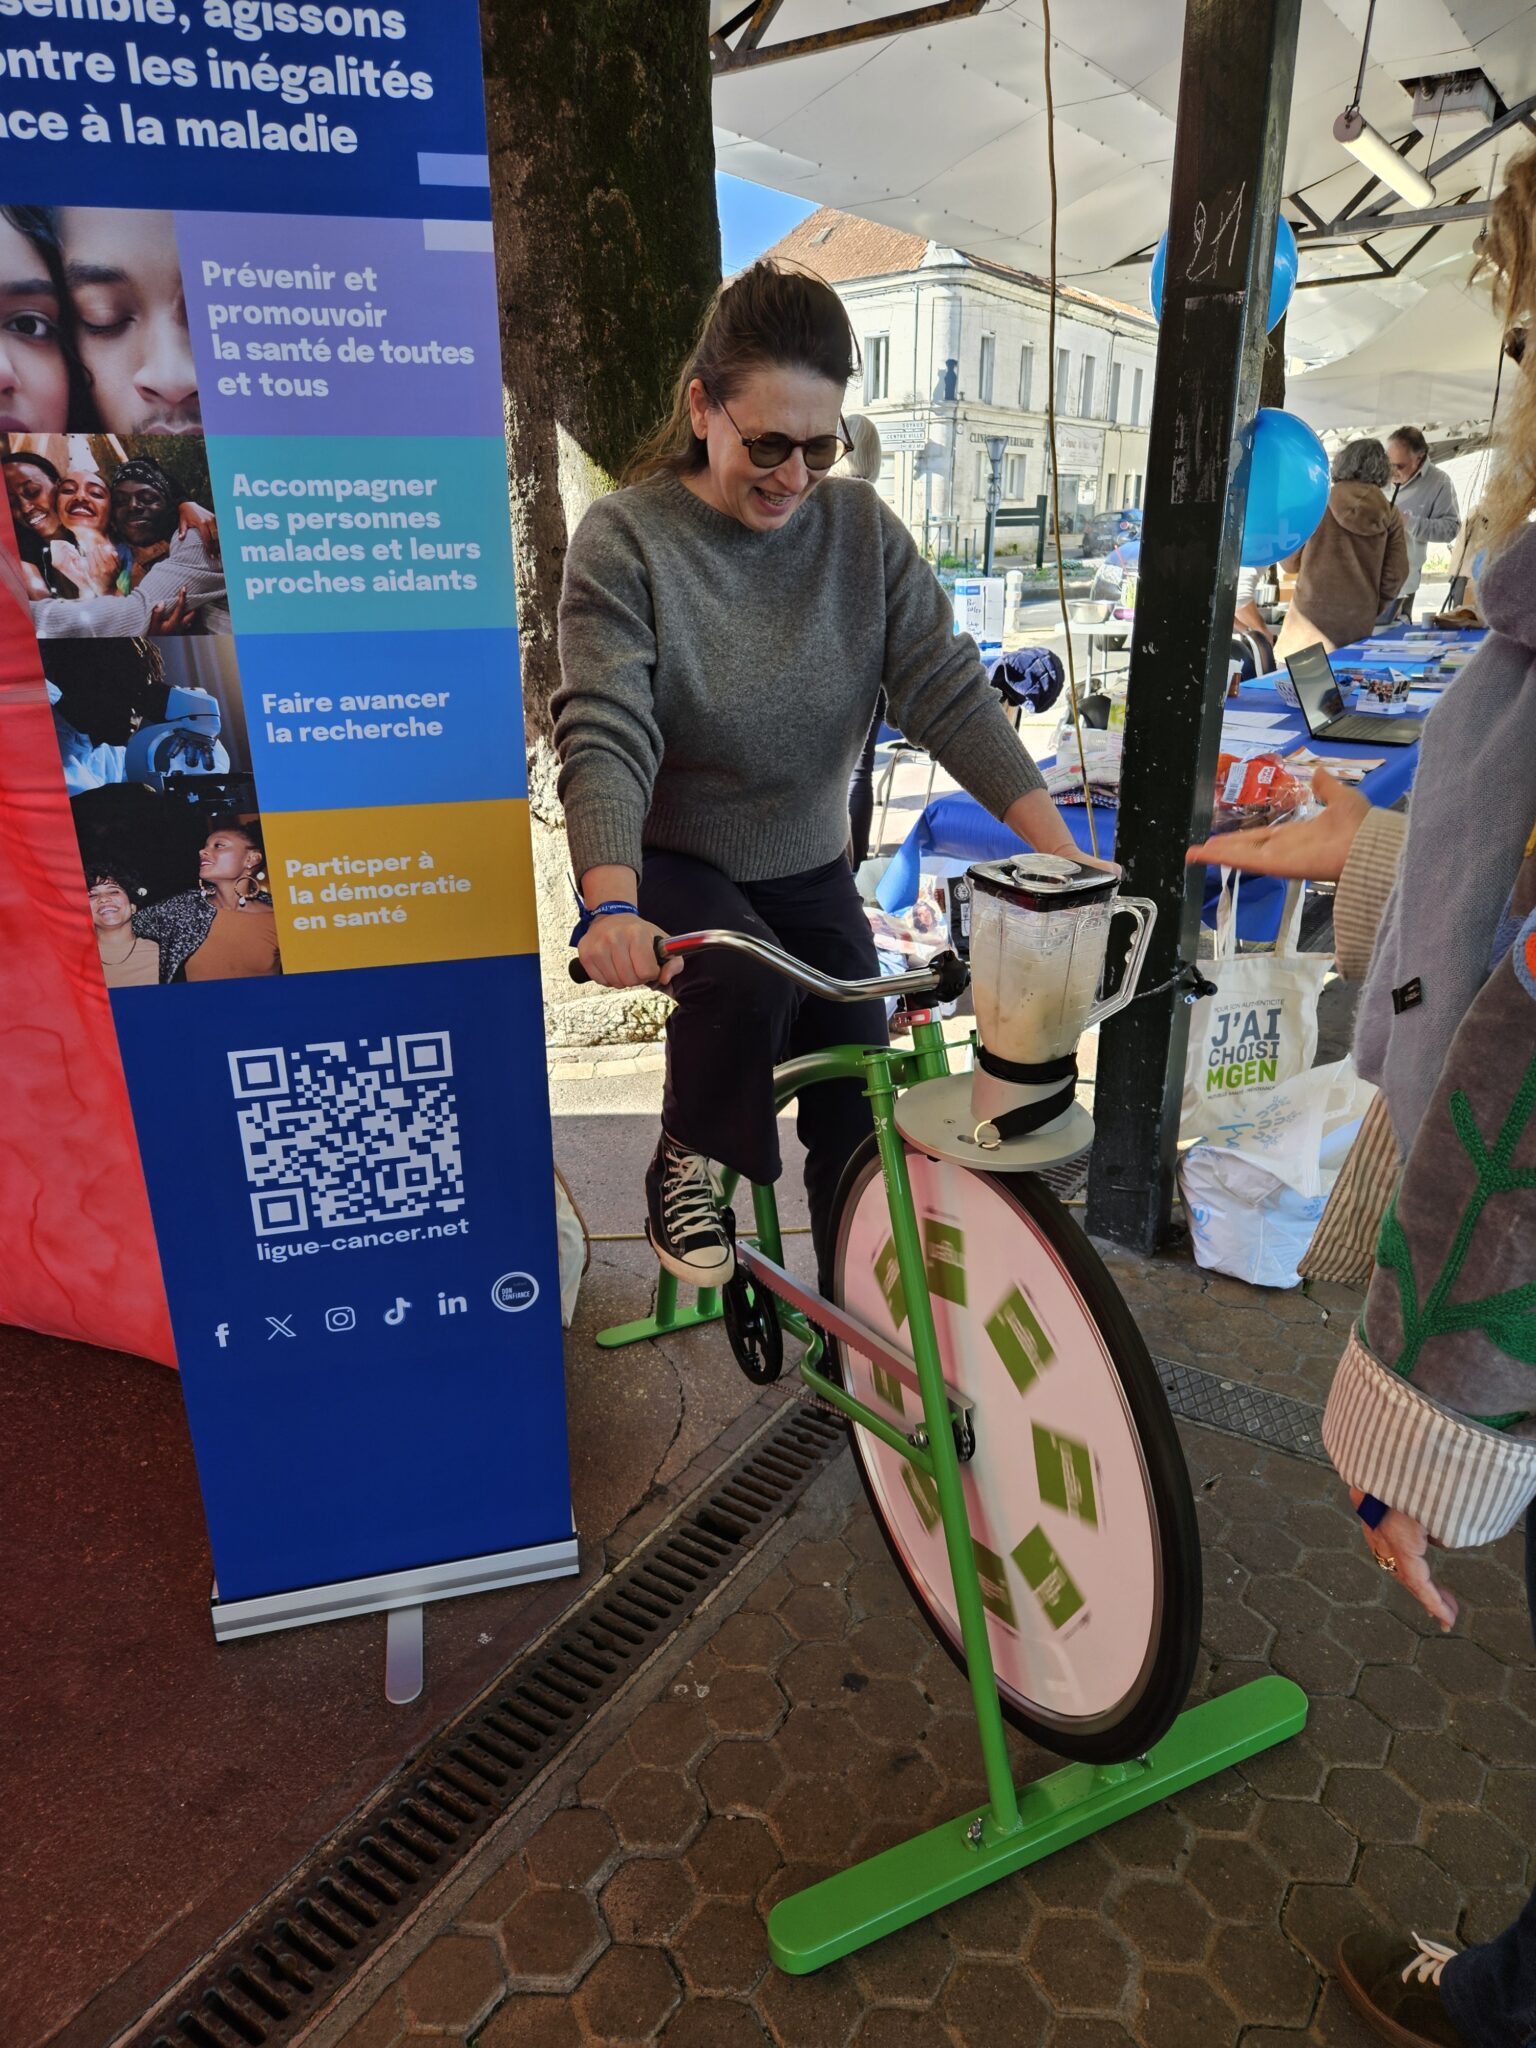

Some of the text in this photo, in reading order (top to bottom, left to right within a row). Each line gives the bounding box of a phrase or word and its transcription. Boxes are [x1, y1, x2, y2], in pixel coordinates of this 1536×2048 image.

[203, 0, 407, 41] agissons
[126, 41, 198, 88] les
[206, 48, 434, 105] inégalités
[80, 103, 111, 143] à
[119, 103, 166, 145] la
[175, 109, 358, 154] maladie
[201, 260, 378, 292] Prévenir et
[207, 301, 388, 330] promouvoir
[211, 333, 475, 365] la santé de toutes
[217, 372, 329, 397] et tous
[232, 473, 438, 502] Accompagner
[235, 505, 441, 534] les personnes
[240, 537, 481, 562] malades et leurs
[245, 568, 478, 600] proches aidants
[262, 691, 450, 714] Faire avancer
[266, 716, 443, 744] la recherche
[285, 850, 434, 881] Particper à
[288, 874, 471, 905] la démocratie
[292, 906, 407, 931] en santé
[1208, 1041, 1280, 1067] CHOISI
[1206, 1059, 1277, 1093] MGEN
[257, 1218, 470, 1264] ligue-cancer.net
[501, 1287, 513, 1295] DON
[501, 1290, 531, 1301] CONFIANCE
